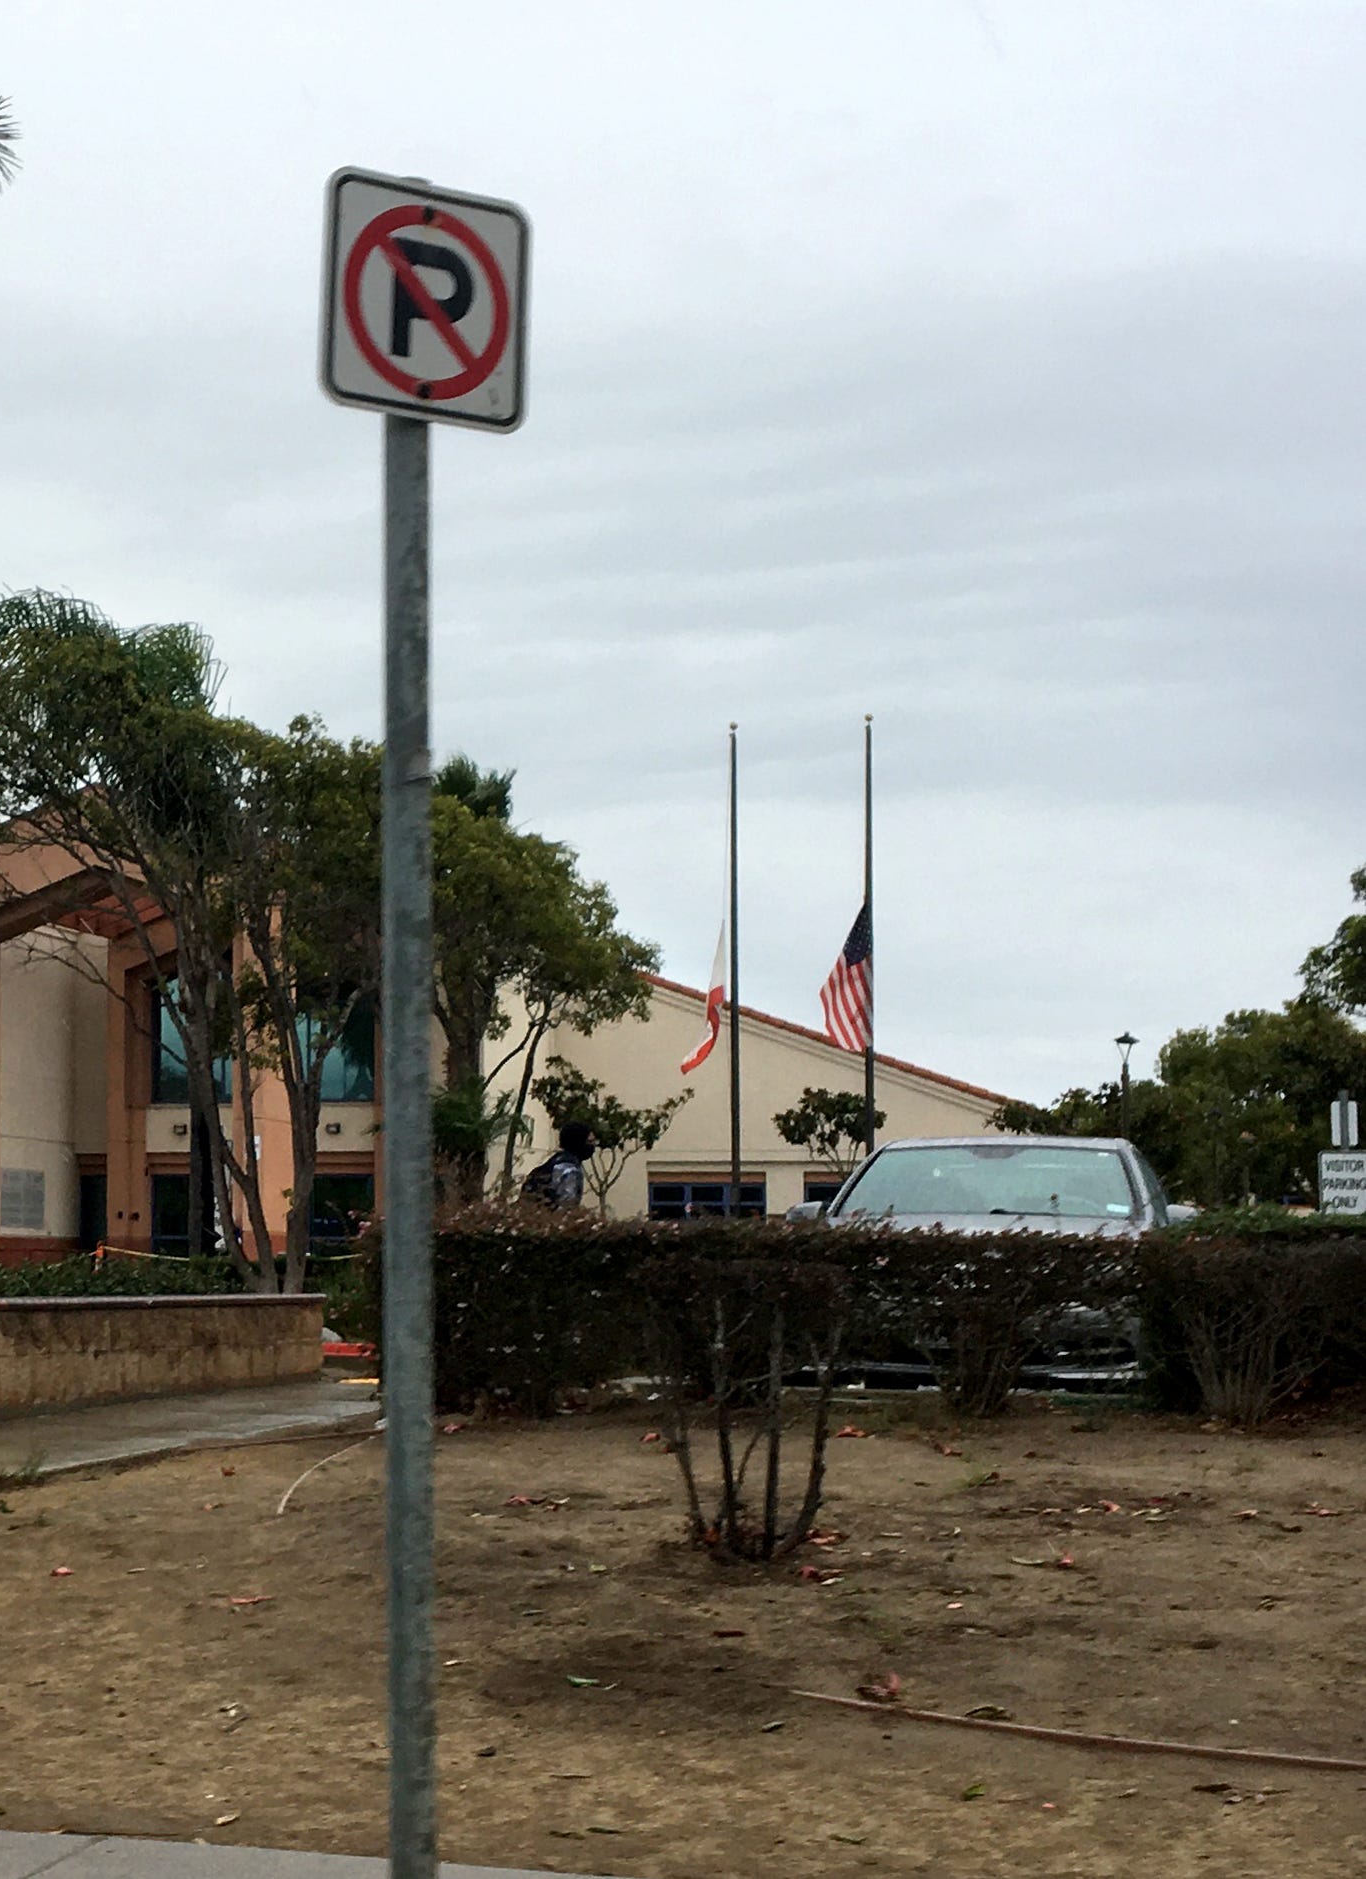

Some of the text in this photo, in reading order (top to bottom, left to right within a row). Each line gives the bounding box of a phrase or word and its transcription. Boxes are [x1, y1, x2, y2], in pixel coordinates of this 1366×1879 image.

[391, 236, 474, 357] P
[1324, 1160, 1365, 1173] VISITOR
[1332, 1196, 1359, 1208] ONLY
